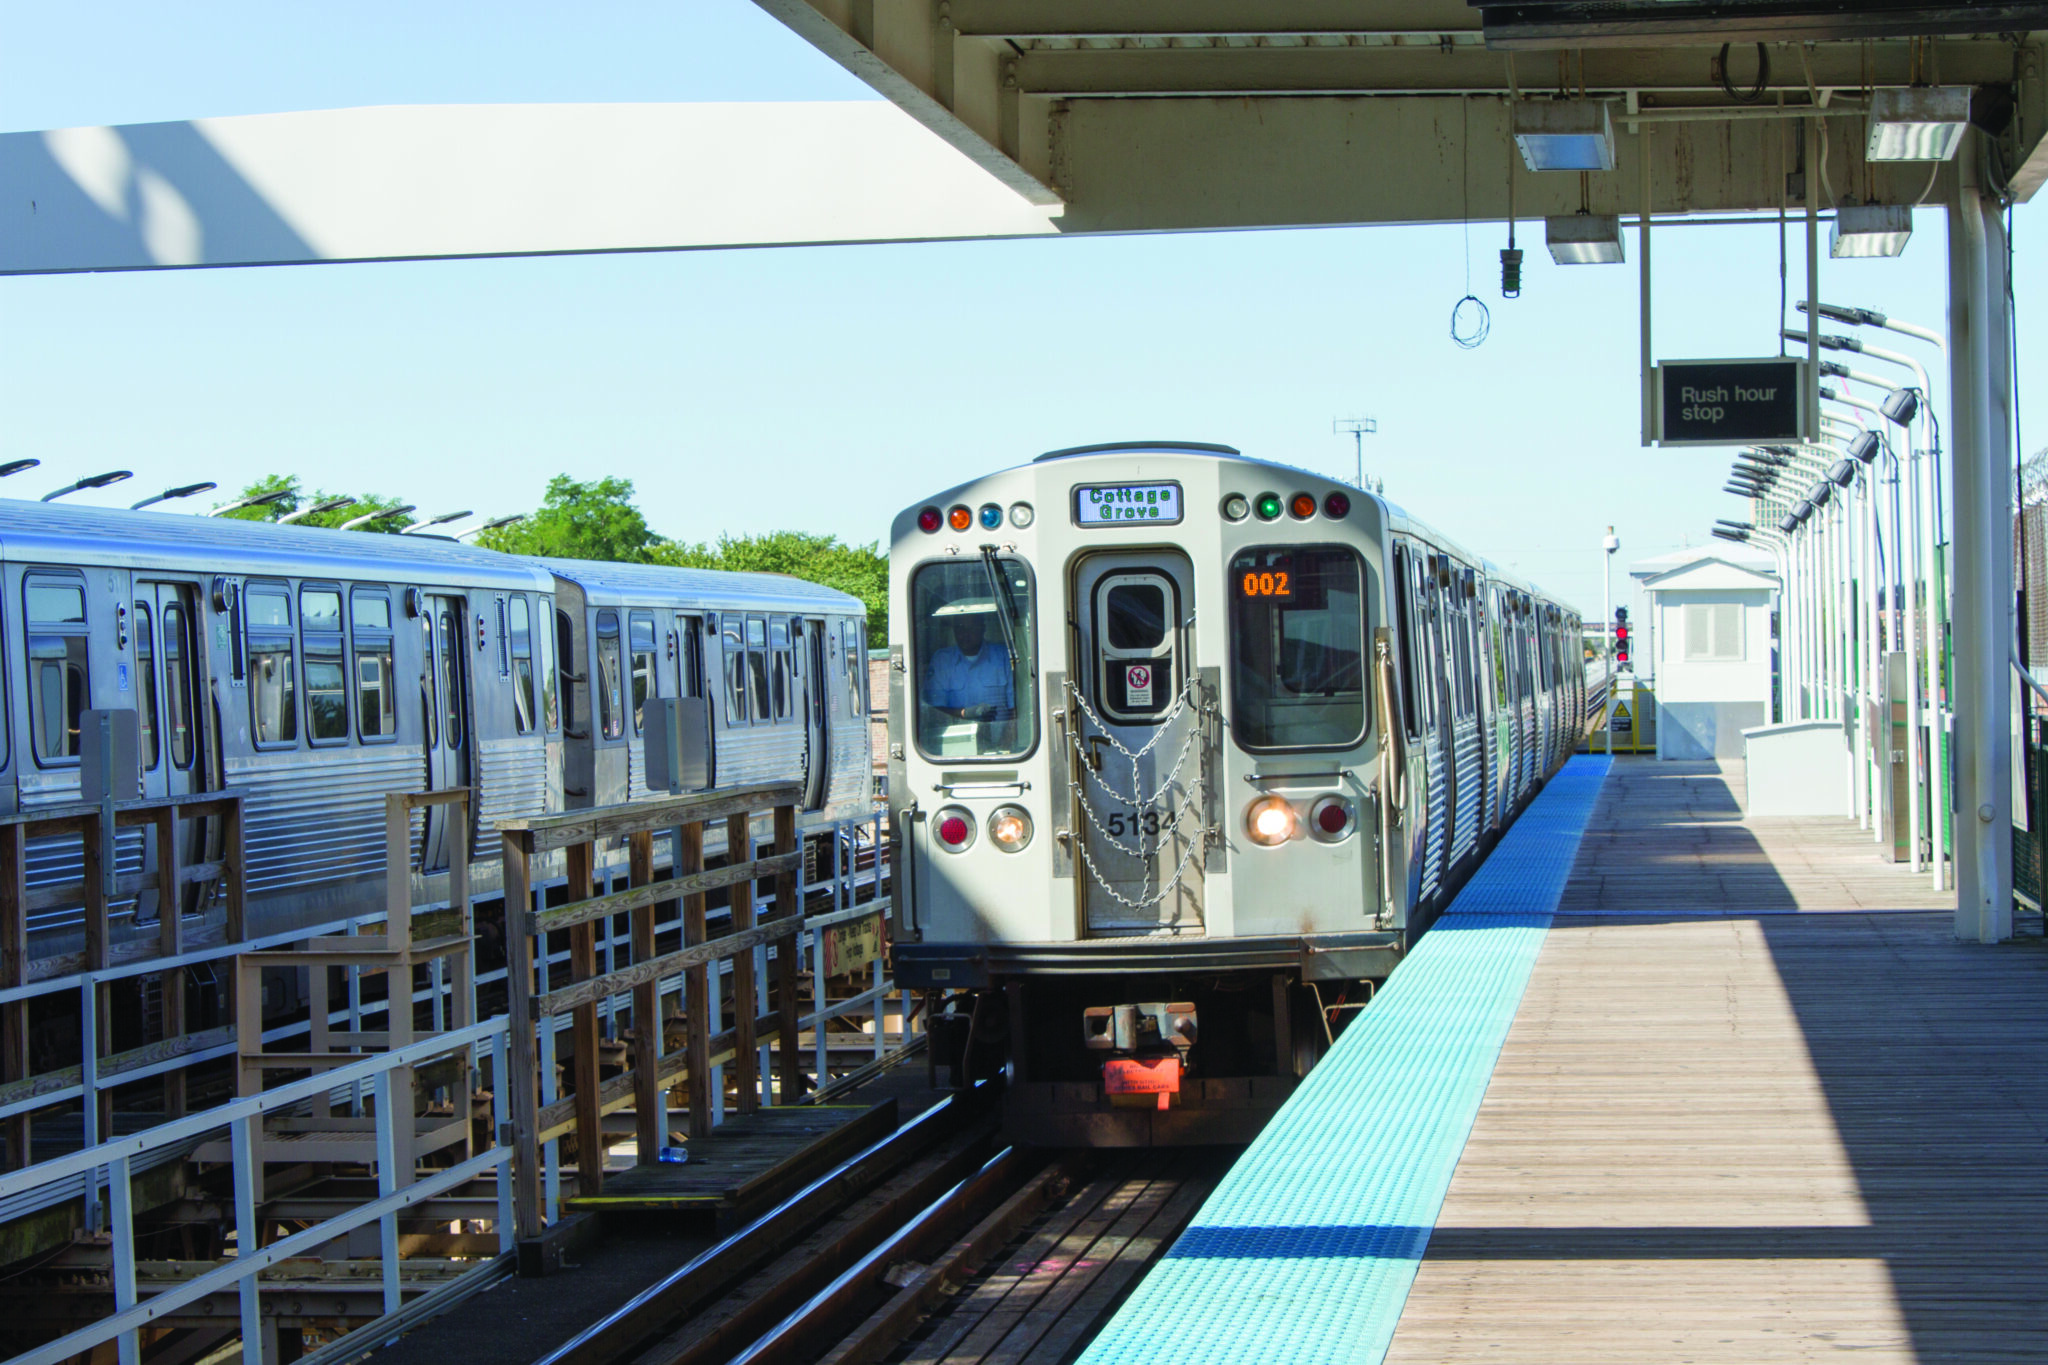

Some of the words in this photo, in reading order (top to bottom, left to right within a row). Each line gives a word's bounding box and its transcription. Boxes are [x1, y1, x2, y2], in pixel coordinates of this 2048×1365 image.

[1682, 386, 1729, 403] Rush
[1735, 385, 1777, 402] hour
[1682, 404, 1724, 423] stop
[1090, 488, 1170, 505] Cottage
[1100, 504, 1159, 519] Grove
[1243, 572, 1290, 596] 002
[1108, 811, 1176, 837] 5134
